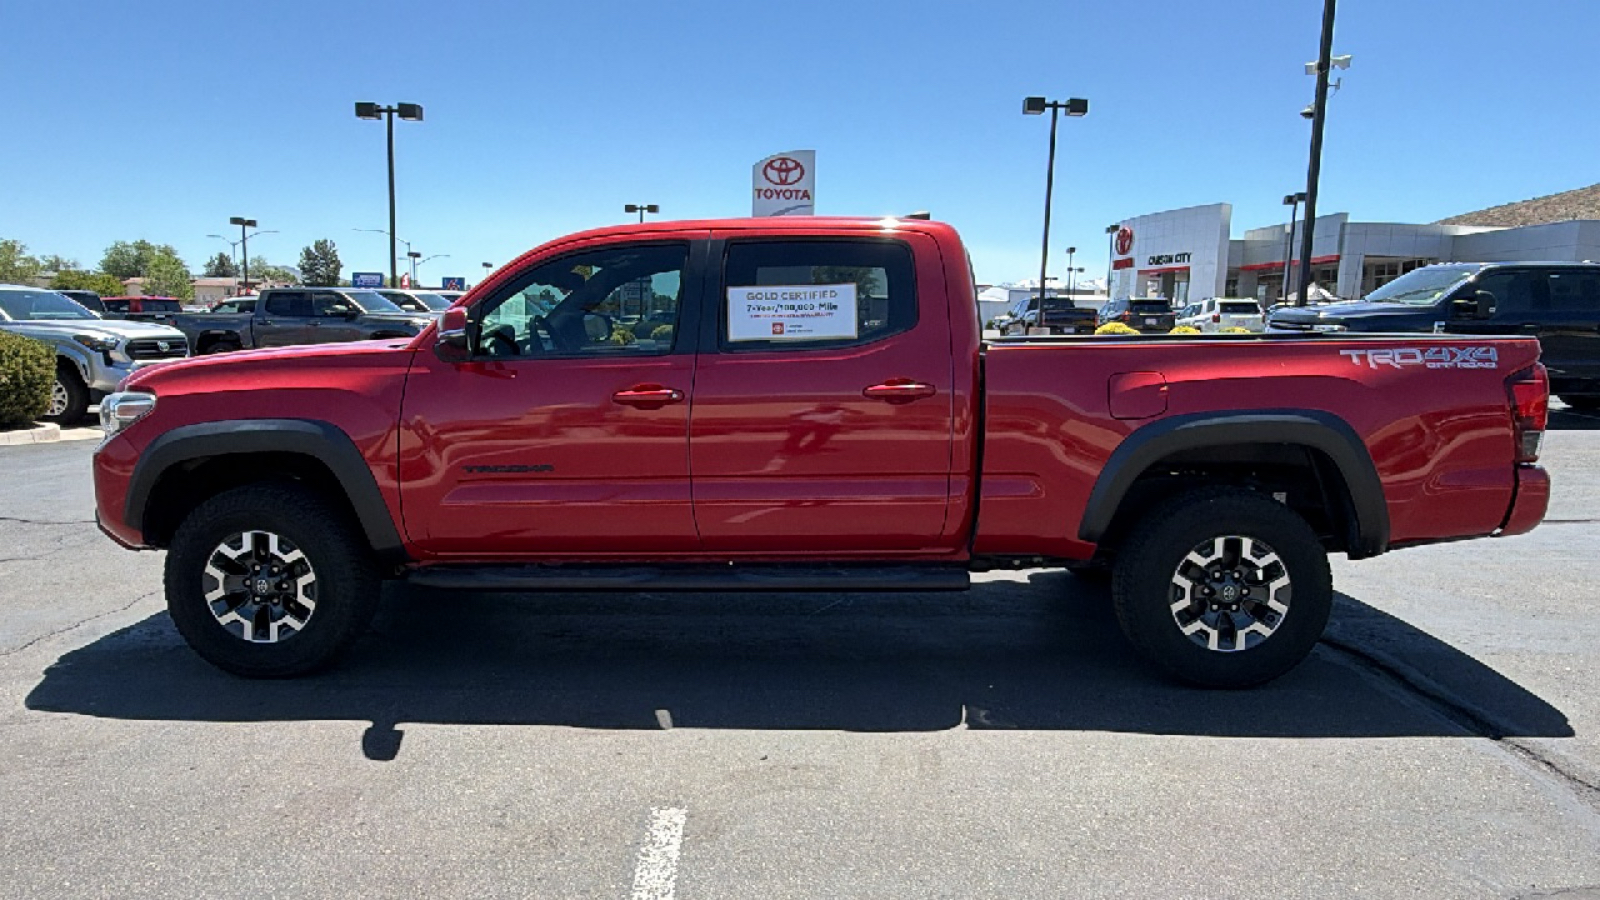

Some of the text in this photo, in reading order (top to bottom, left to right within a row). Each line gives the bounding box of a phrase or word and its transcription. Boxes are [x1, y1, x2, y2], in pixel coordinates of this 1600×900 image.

[755, 188, 811, 200] TOYOTA
[1174, 252, 1191, 263] CITY
[746, 289, 838, 301] GOLD CERTIFIED
[1339, 349, 1424, 369] TRD
